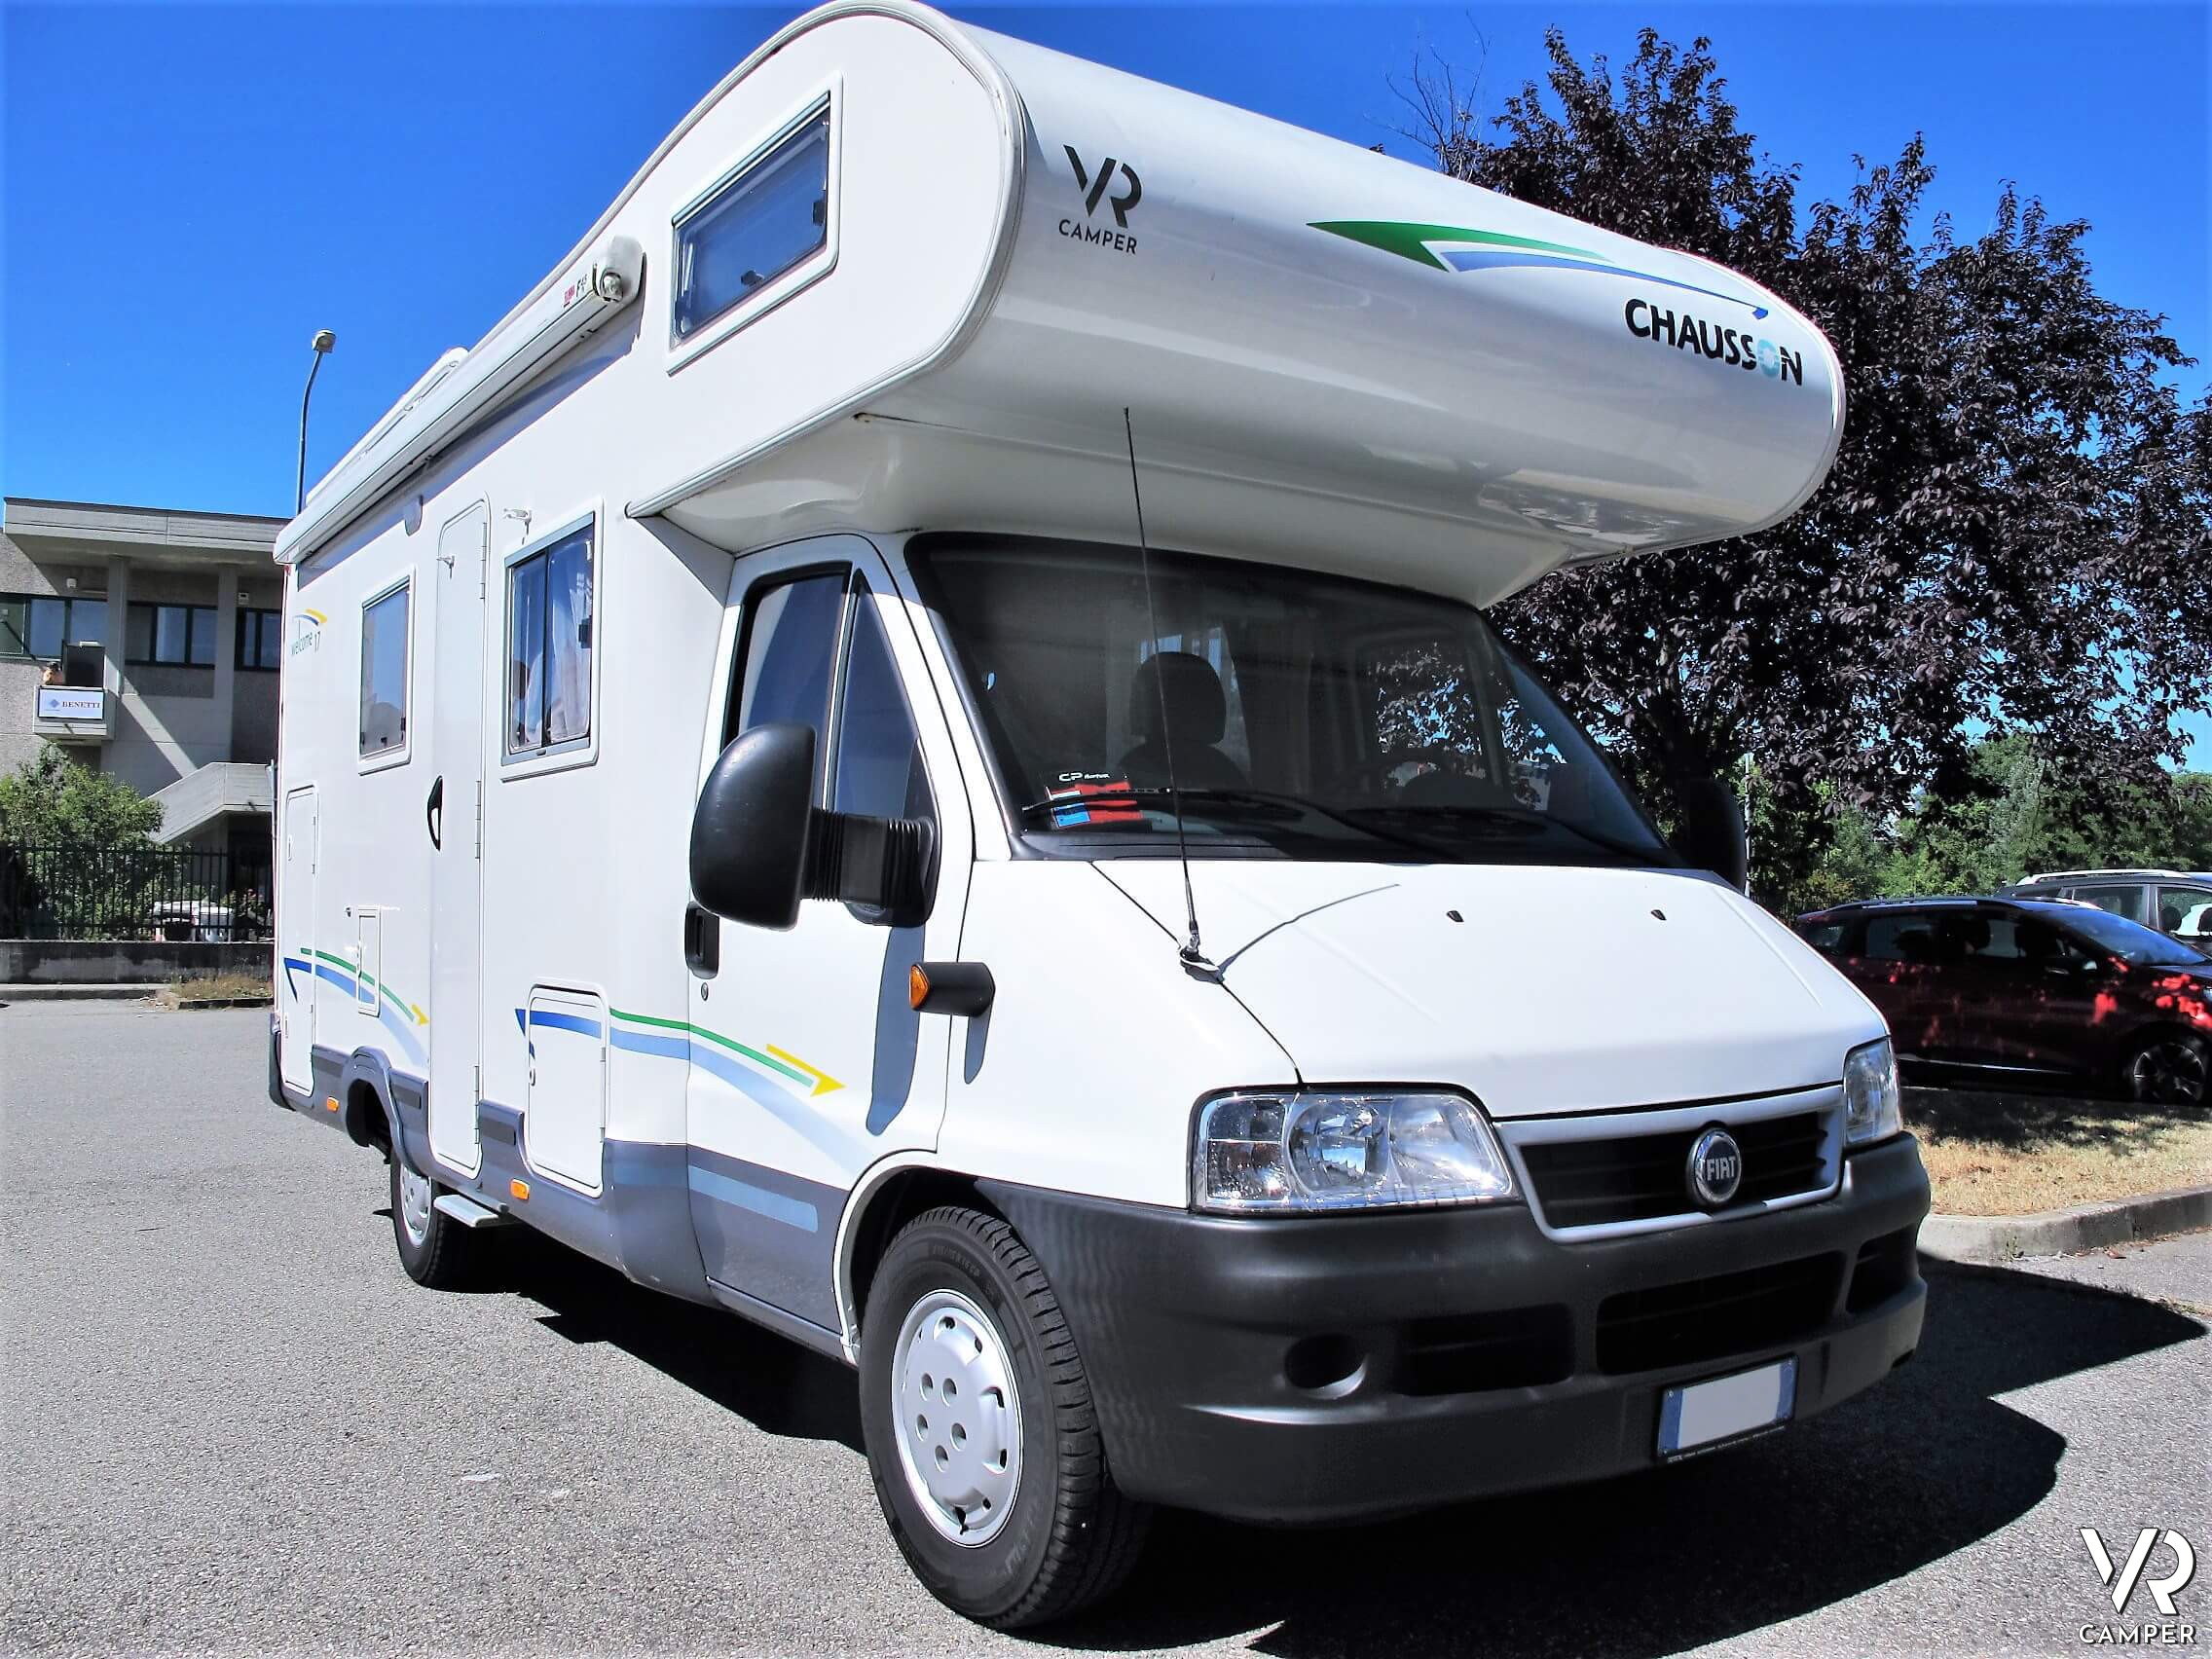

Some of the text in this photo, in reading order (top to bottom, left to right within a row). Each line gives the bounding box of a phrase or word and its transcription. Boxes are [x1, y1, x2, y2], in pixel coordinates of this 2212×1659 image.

[1062, 143, 1142, 229] VR
[1058, 218, 1137, 254] CAMPER
[1624, 298, 1802, 387] CHAUSSON
[1058, 773, 1084, 782] CP
[1706, 1156, 1736, 1182] FIAT
